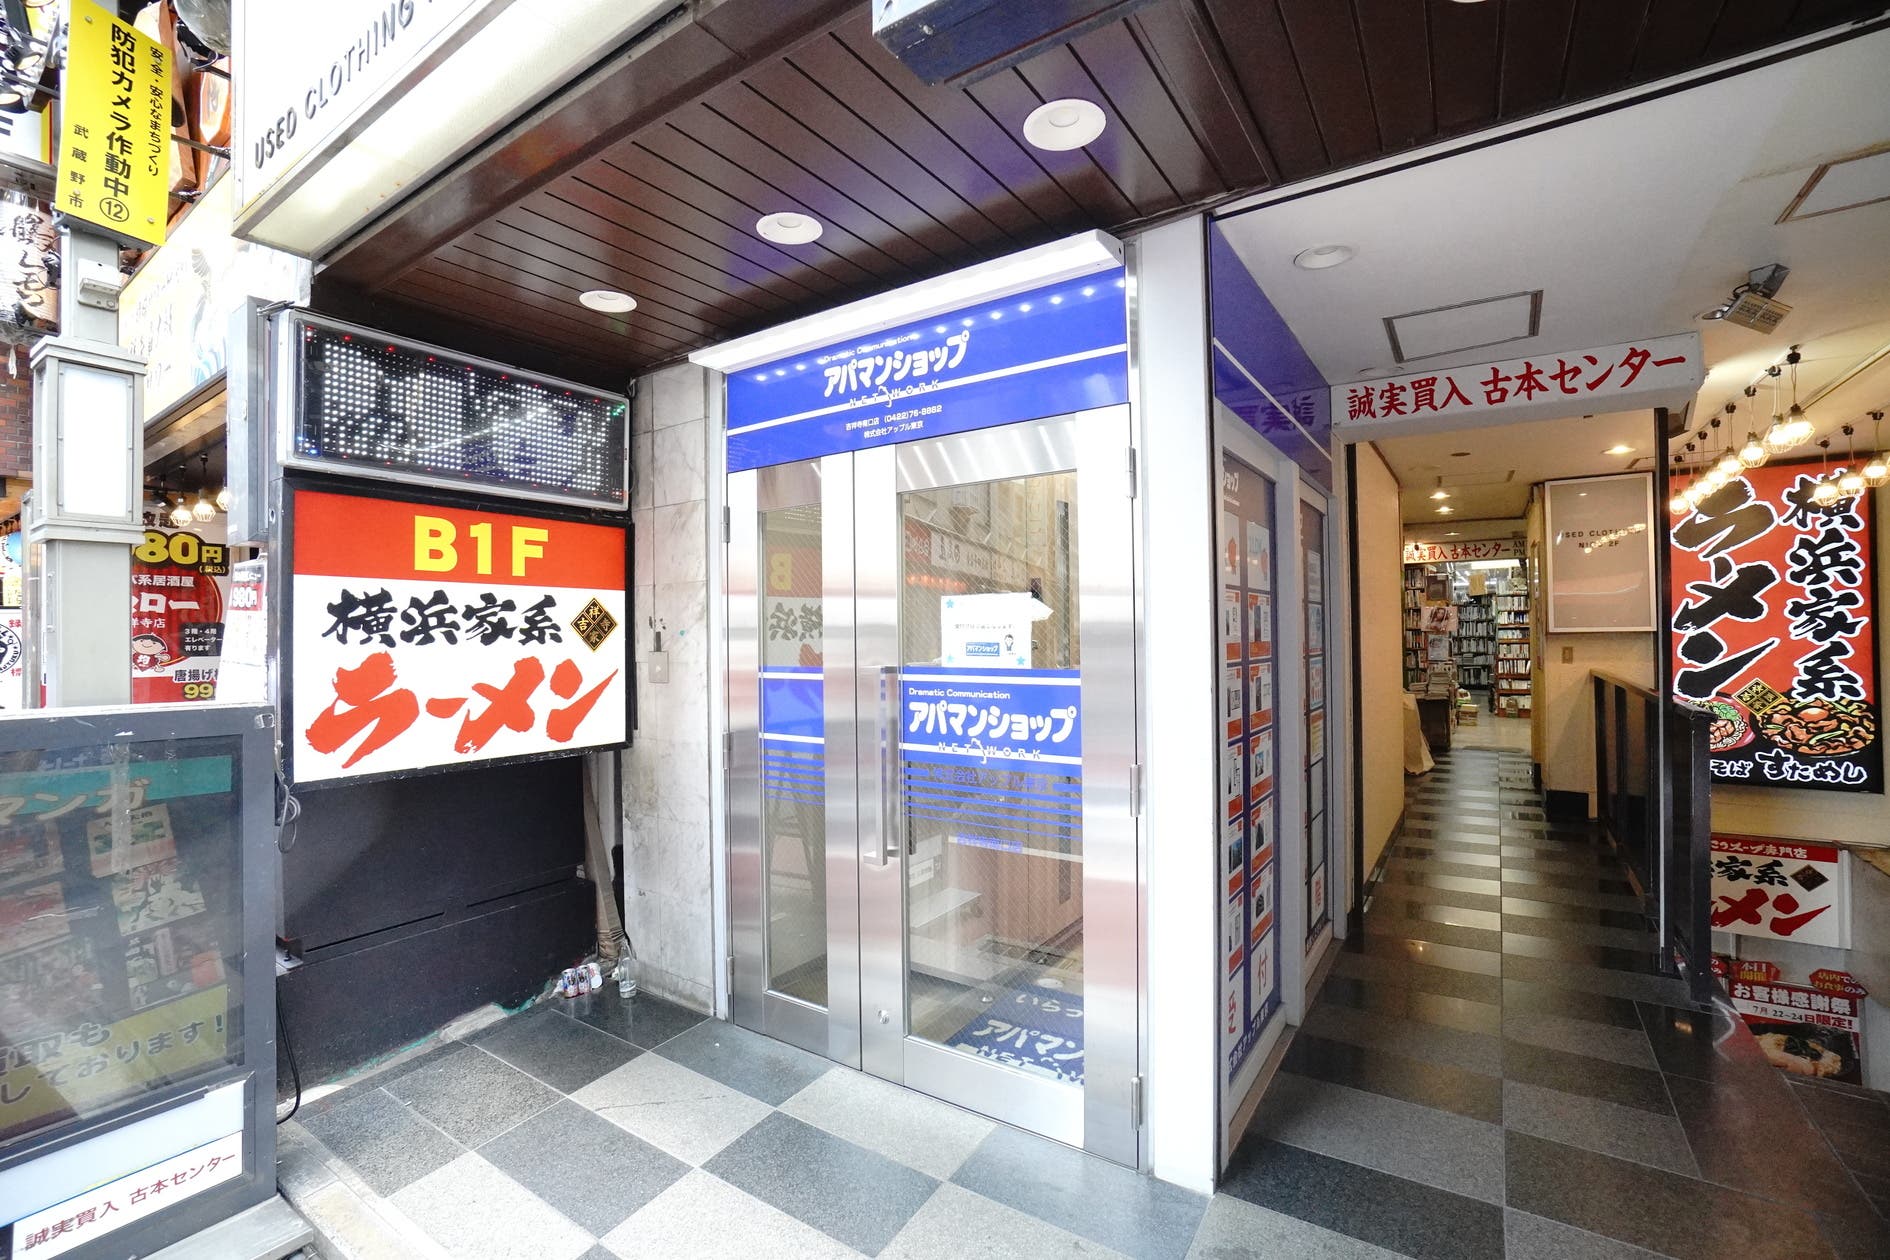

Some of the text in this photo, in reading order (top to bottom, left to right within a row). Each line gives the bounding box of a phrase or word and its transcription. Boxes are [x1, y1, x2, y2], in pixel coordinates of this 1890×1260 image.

[102, 22, 137, 198] 防犯カメラ作動中
[255, 0, 414, 169] USED CLOTHING
[67, 124, 90, 209] 武蔵野市
[823, 330, 970, 398] アパマンショップ
[1346, 346, 1687, 421] 誠実買入 古本センター
[131, 531, 222, 565] 80円
[413, 514, 549, 577] B1F
[1405, 543, 1510, 562] 誠実買入 古本センター
[321, 586, 564, 649] 横浜家系
[1670, 475, 1781, 701] ラーメン
[1780, 467, 1869, 702] 横浜家系
[305, 650, 620, 769] ラーメン
[908, 687, 1011, 701] Dramatic Communication
[908, 700, 1078, 743] アパマンショップ
[1733, 982, 1852, 1015] お客様感謝祭
[24, 1153, 236, 1251] 誠実買入 古本センター
